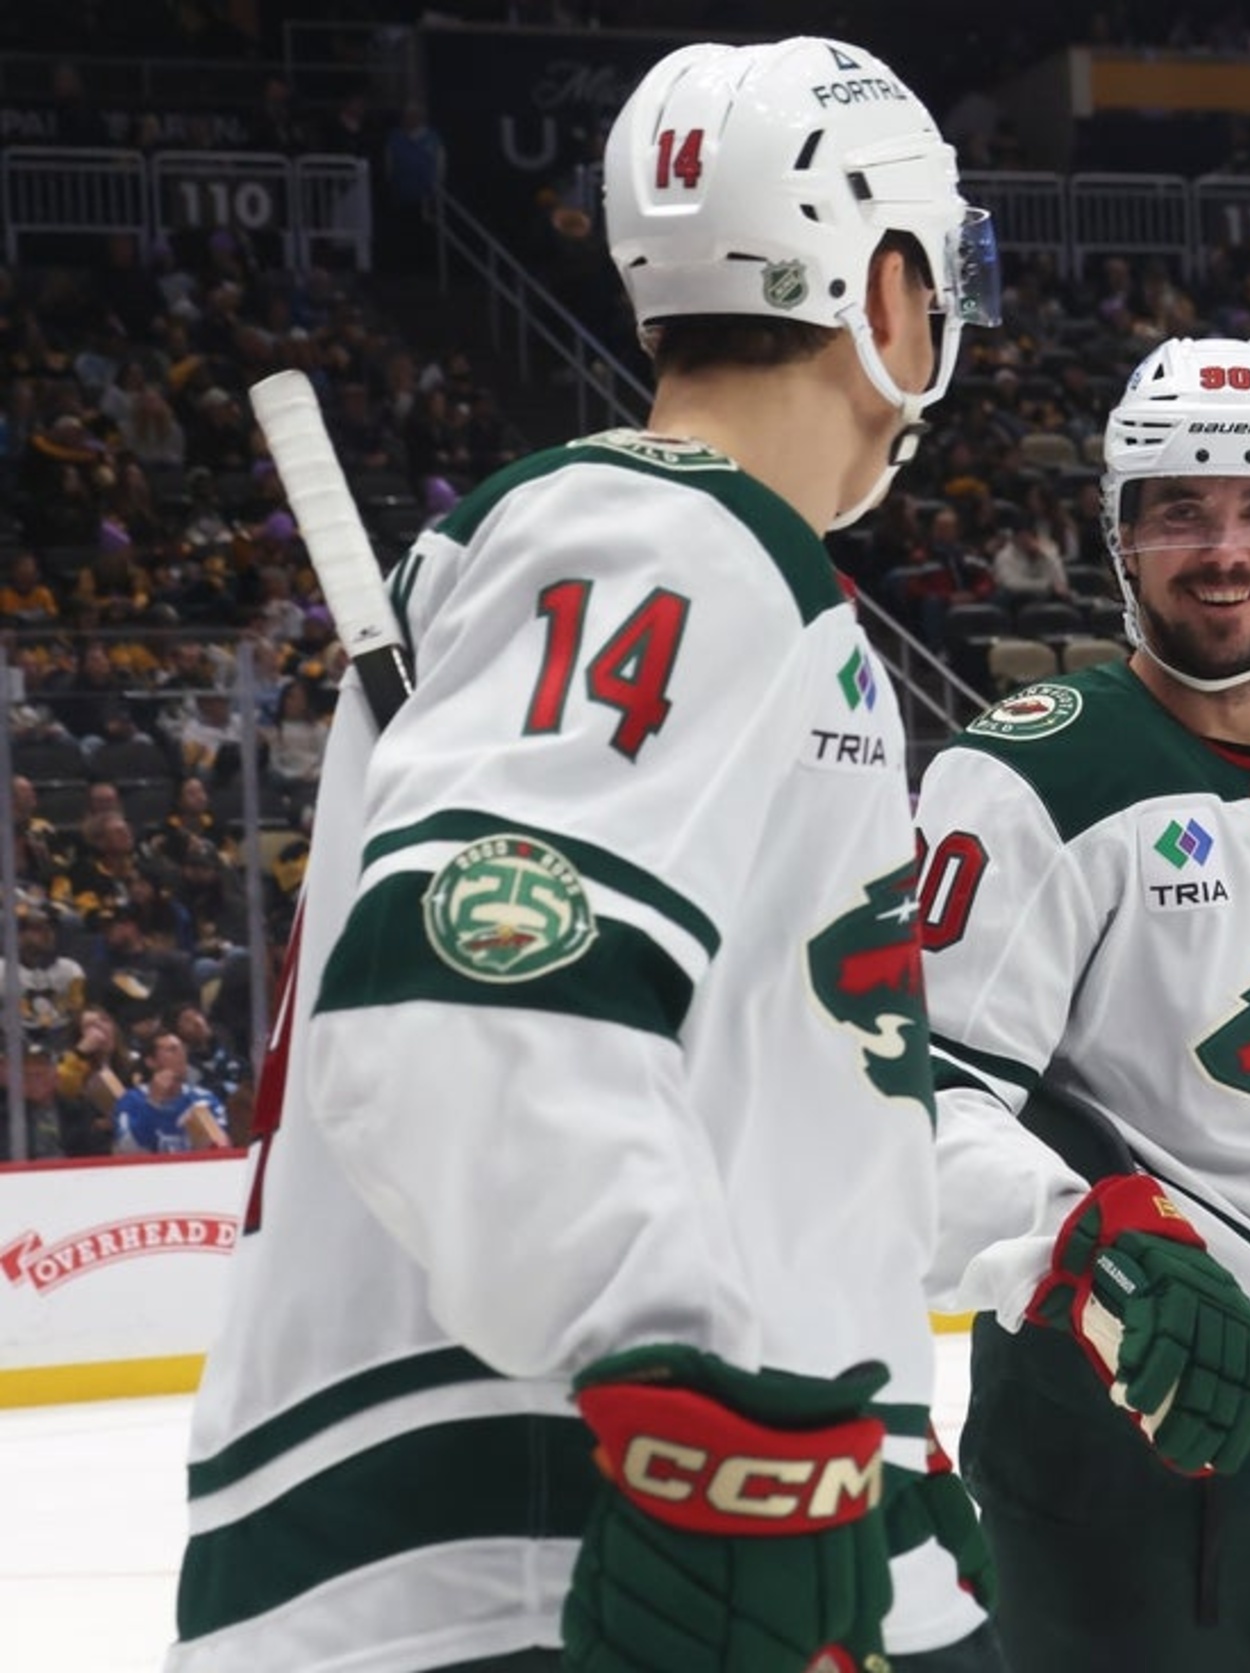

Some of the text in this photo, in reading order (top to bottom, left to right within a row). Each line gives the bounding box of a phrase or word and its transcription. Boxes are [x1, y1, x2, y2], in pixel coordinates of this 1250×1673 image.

[656, 129, 704, 188] 14
[180, 181, 272, 229] 110
[521, 578, 692, 766] 14
[811, 729, 887, 767] TRIA
[1149, 879, 1229, 906] TRIA
[34, 1220, 209, 1283] OVERHEAD
[622, 1435, 884, 1519] CCM
